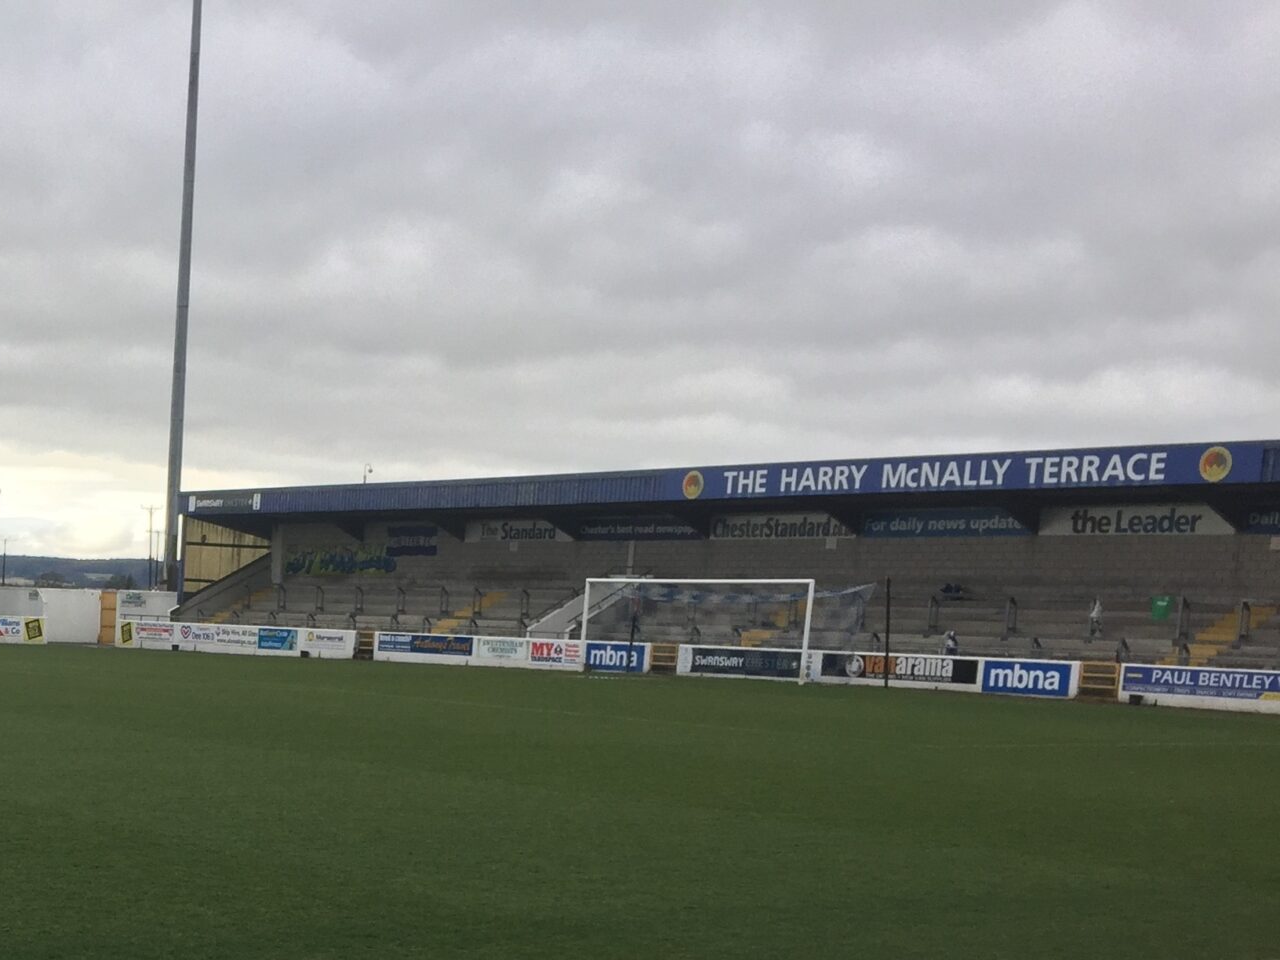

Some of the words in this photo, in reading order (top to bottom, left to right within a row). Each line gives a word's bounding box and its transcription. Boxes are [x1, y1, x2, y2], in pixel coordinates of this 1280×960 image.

[723, 469, 768, 494] THE
[780, 464, 869, 493] HARRY
[1025, 452, 1168, 484] TERRACE
[616, 524, 633, 533] best
[634, 523, 655, 533] read
[865, 519, 887, 532] For
[889, 516, 925, 534] daily
[927, 519, 966, 531] news
[970, 514, 1023, 535] update
[1072, 508, 1112, 534] the
[1114, 508, 1203, 534] Leader
[1248, 511, 1280, 525] Dail
[480, 523, 499, 537] The
[500, 521, 556, 540] Standard
[531, 642, 555, 656] MY
[589, 646, 637, 667] mbna
[694, 654, 744, 667] SWANSWAY
[865, 656, 954, 678] vanarama
[989, 663, 1061, 691] mbna
[1151, 669, 1194, 686] PAUL
[1198, 672, 1274, 689] BENTLEY
